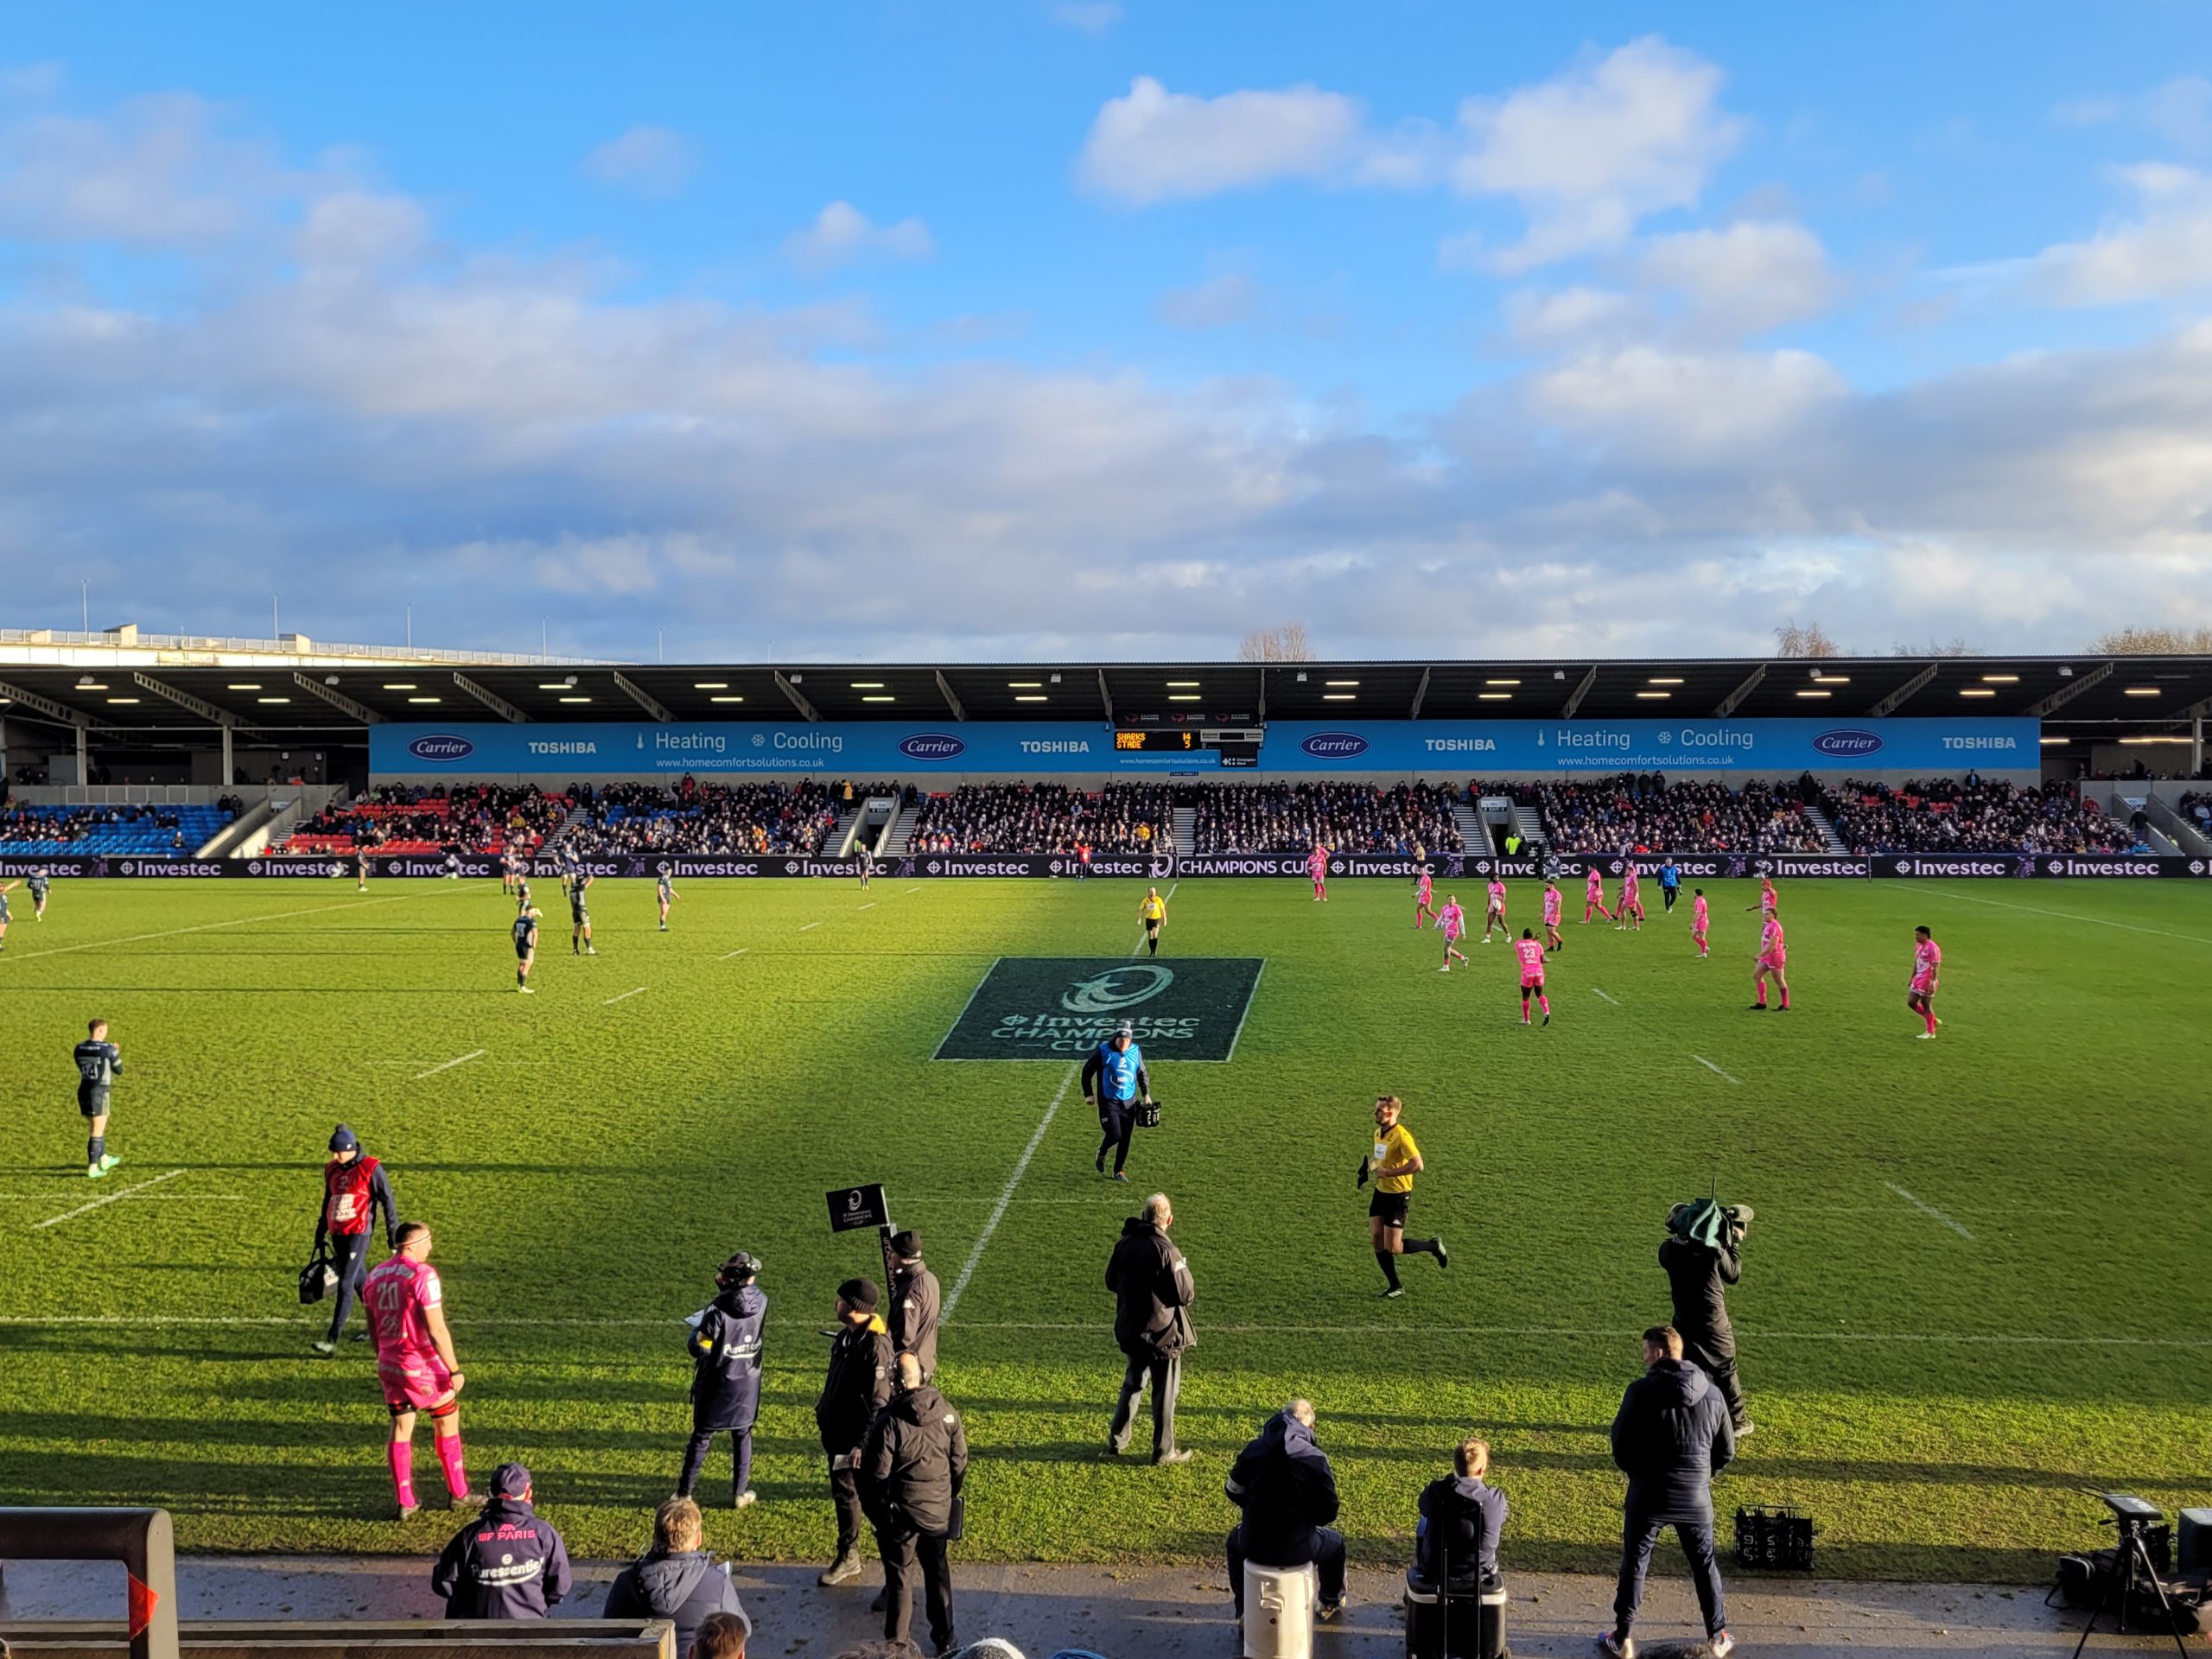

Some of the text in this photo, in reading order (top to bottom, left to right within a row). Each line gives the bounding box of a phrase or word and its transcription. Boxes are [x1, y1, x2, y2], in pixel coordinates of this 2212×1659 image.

[656, 732, 726, 751] Heating
[774, 732, 842, 751] Cooling
[1310, 739, 1360, 752] Carrier
[1426, 739, 1496, 751] TOSHIBA
[1558, 729, 1630, 749] Heating
[1681, 729, 1753, 749] Cooling
[1822, 737, 1874, 750] Carrier
[1942, 737, 2016, 749] TOSHIBA
[416, 741, 467, 754] Carrier
[529, 742, 596, 753] TOSHIBA
[907, 741, 957, 753] Carrier
[1021, 741, 1089, 753] TOSHIBA
[656, 758, 823, 768] www.homecomfortsolutions.co.uk
[1558, 756, 1734, 766] www.homecomfortsolutions.co.uk
[138, 861, 221, 875] Investec
[406, 861, 489, 875] Invetec
[534, 861, 617, 875] Invstec
[675, 861, 758, 875] Investec
[944, 860, 1029, 875] Investec
[1179, 861, 1277, 874] CHAMPIONS
[1495, 860, 1581, 874] Inveec
[1777, 860, 1866, 874] Investec
[1915, 860, 2005, 874] Investec
[2067, 860, 2159, 875] Investec
[991, 1027, 1194, 1039] CHAMPONS
[1051, 1039, 1109, 1052] CU
[376, 1281, 400, 1311] 20
[478, 1529, 536, 1542] SF PARIS
